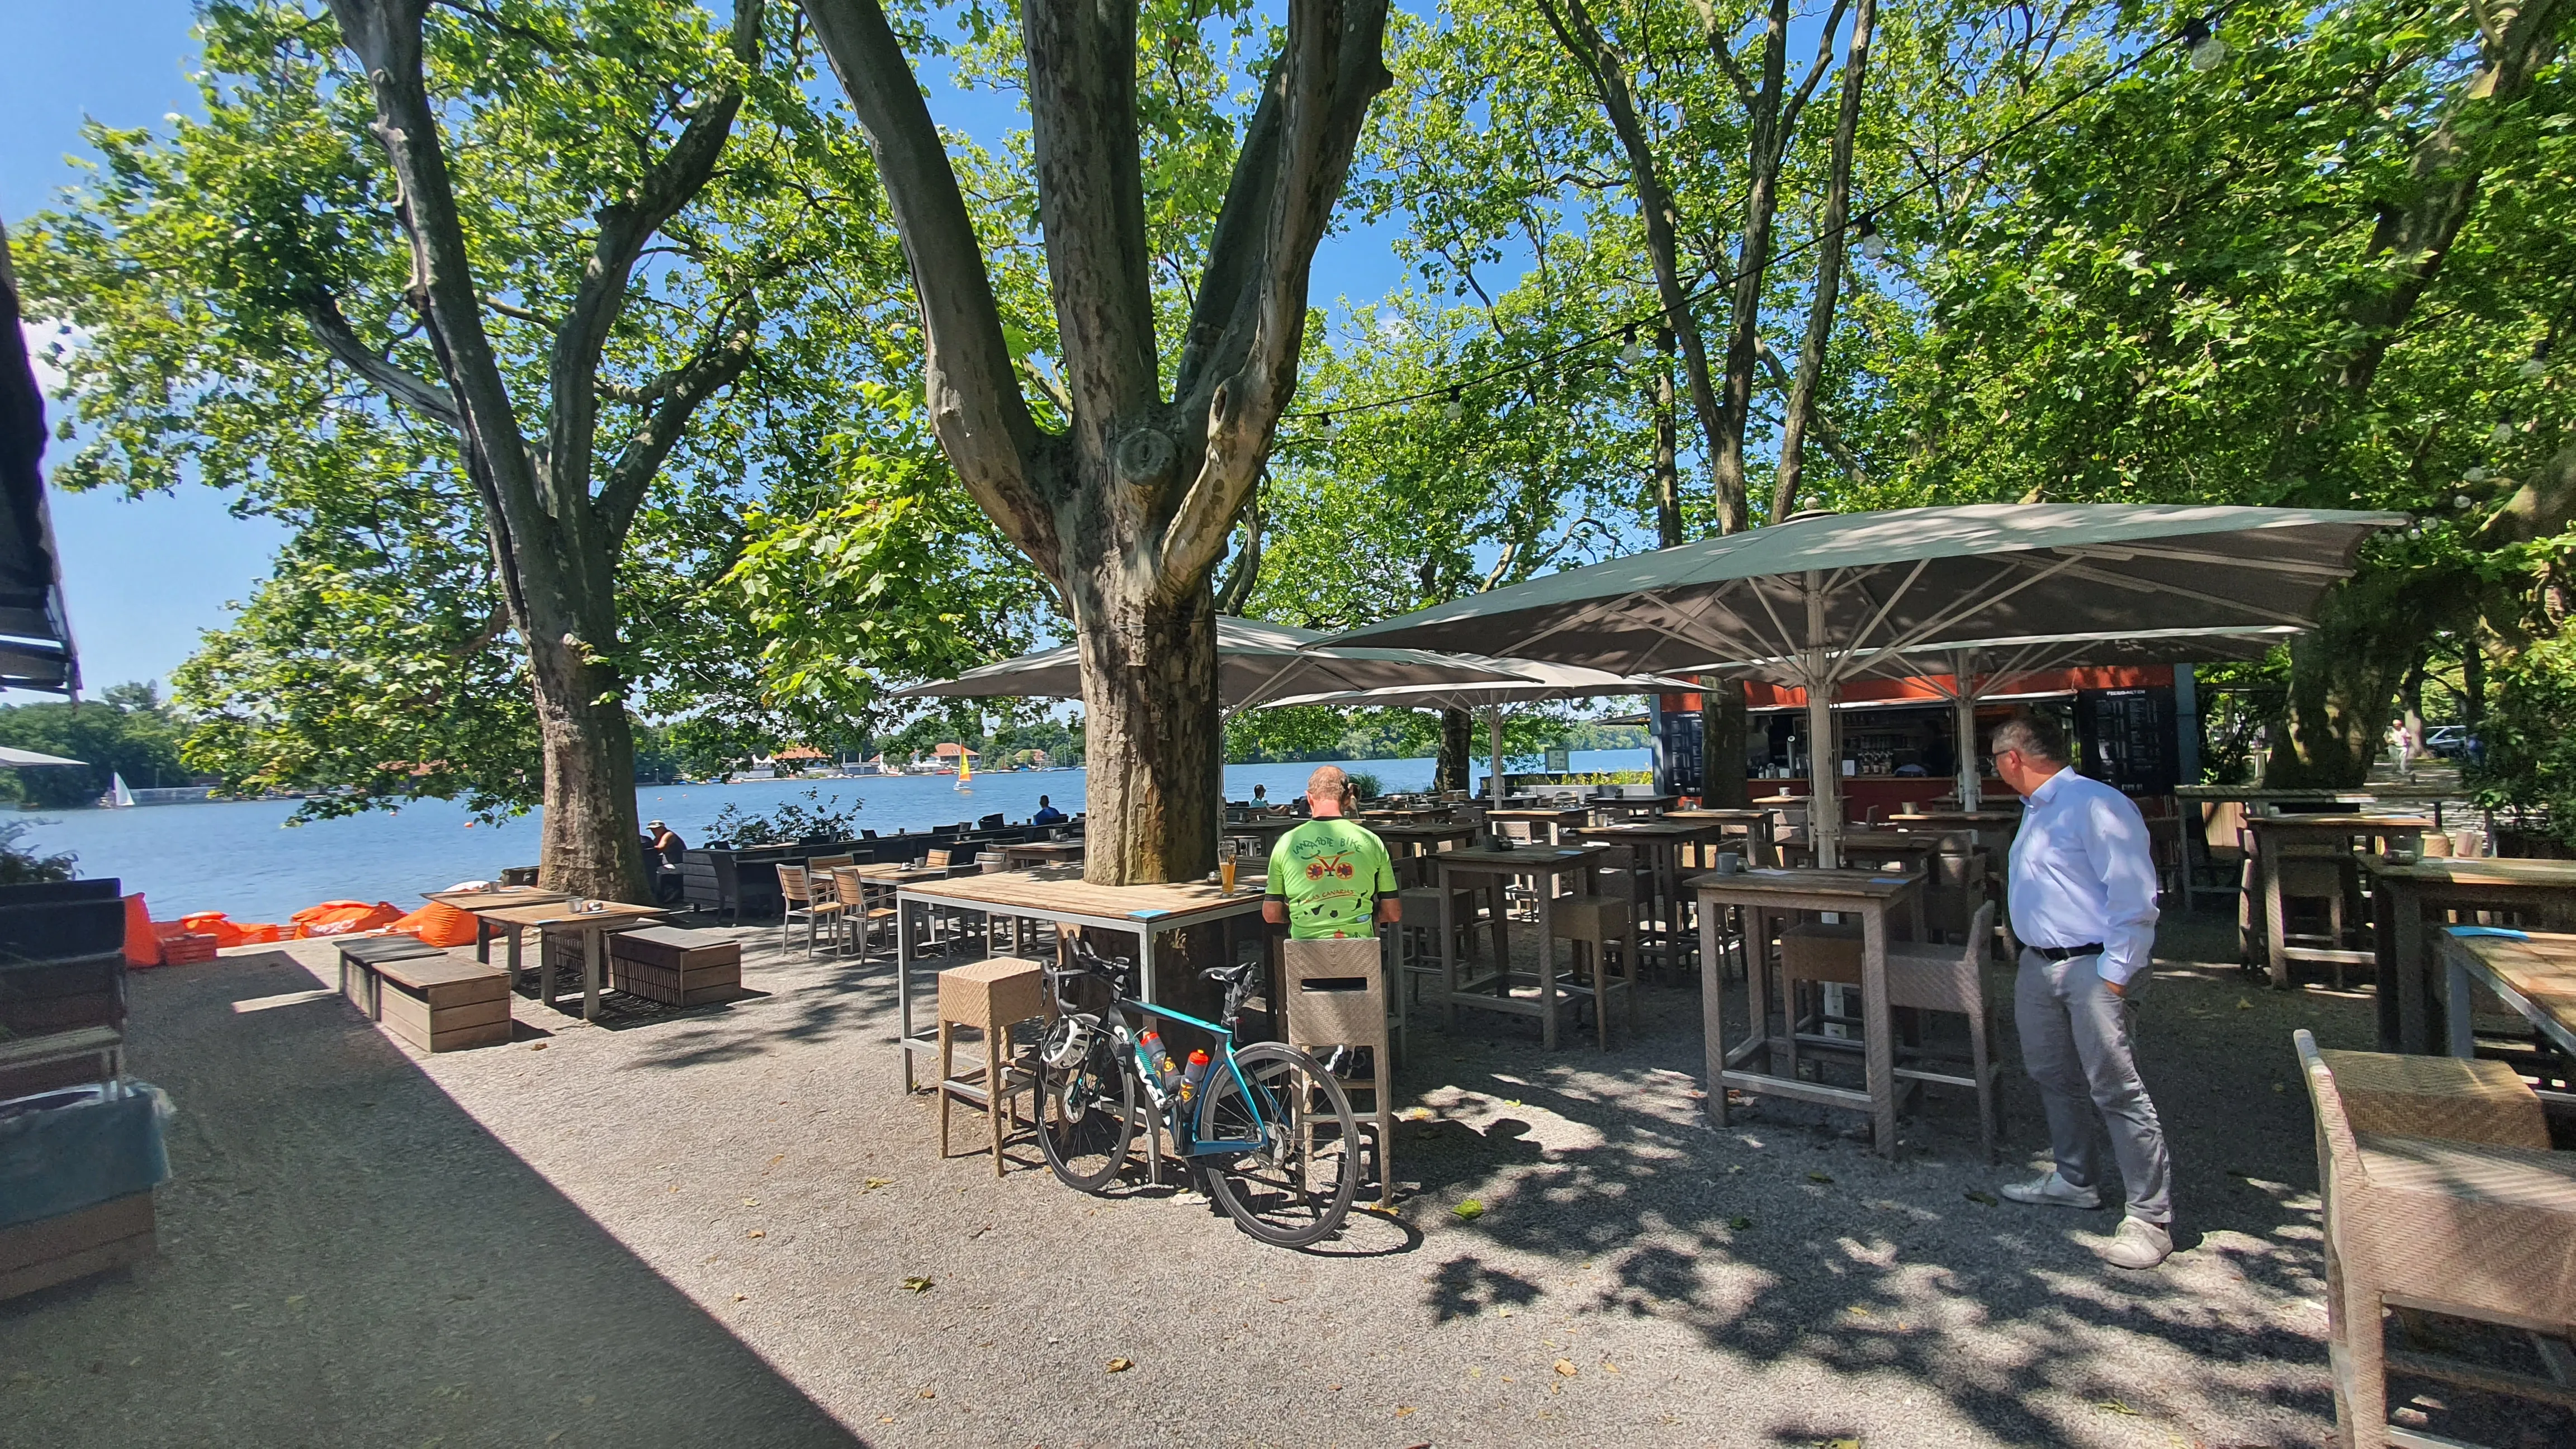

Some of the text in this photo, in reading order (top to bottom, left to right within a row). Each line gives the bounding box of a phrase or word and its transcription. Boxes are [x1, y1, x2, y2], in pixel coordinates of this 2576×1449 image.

[1340, 837, 1362, 853] BIKE
[1303, 889, 1354, 903] LAS CANARIAS
